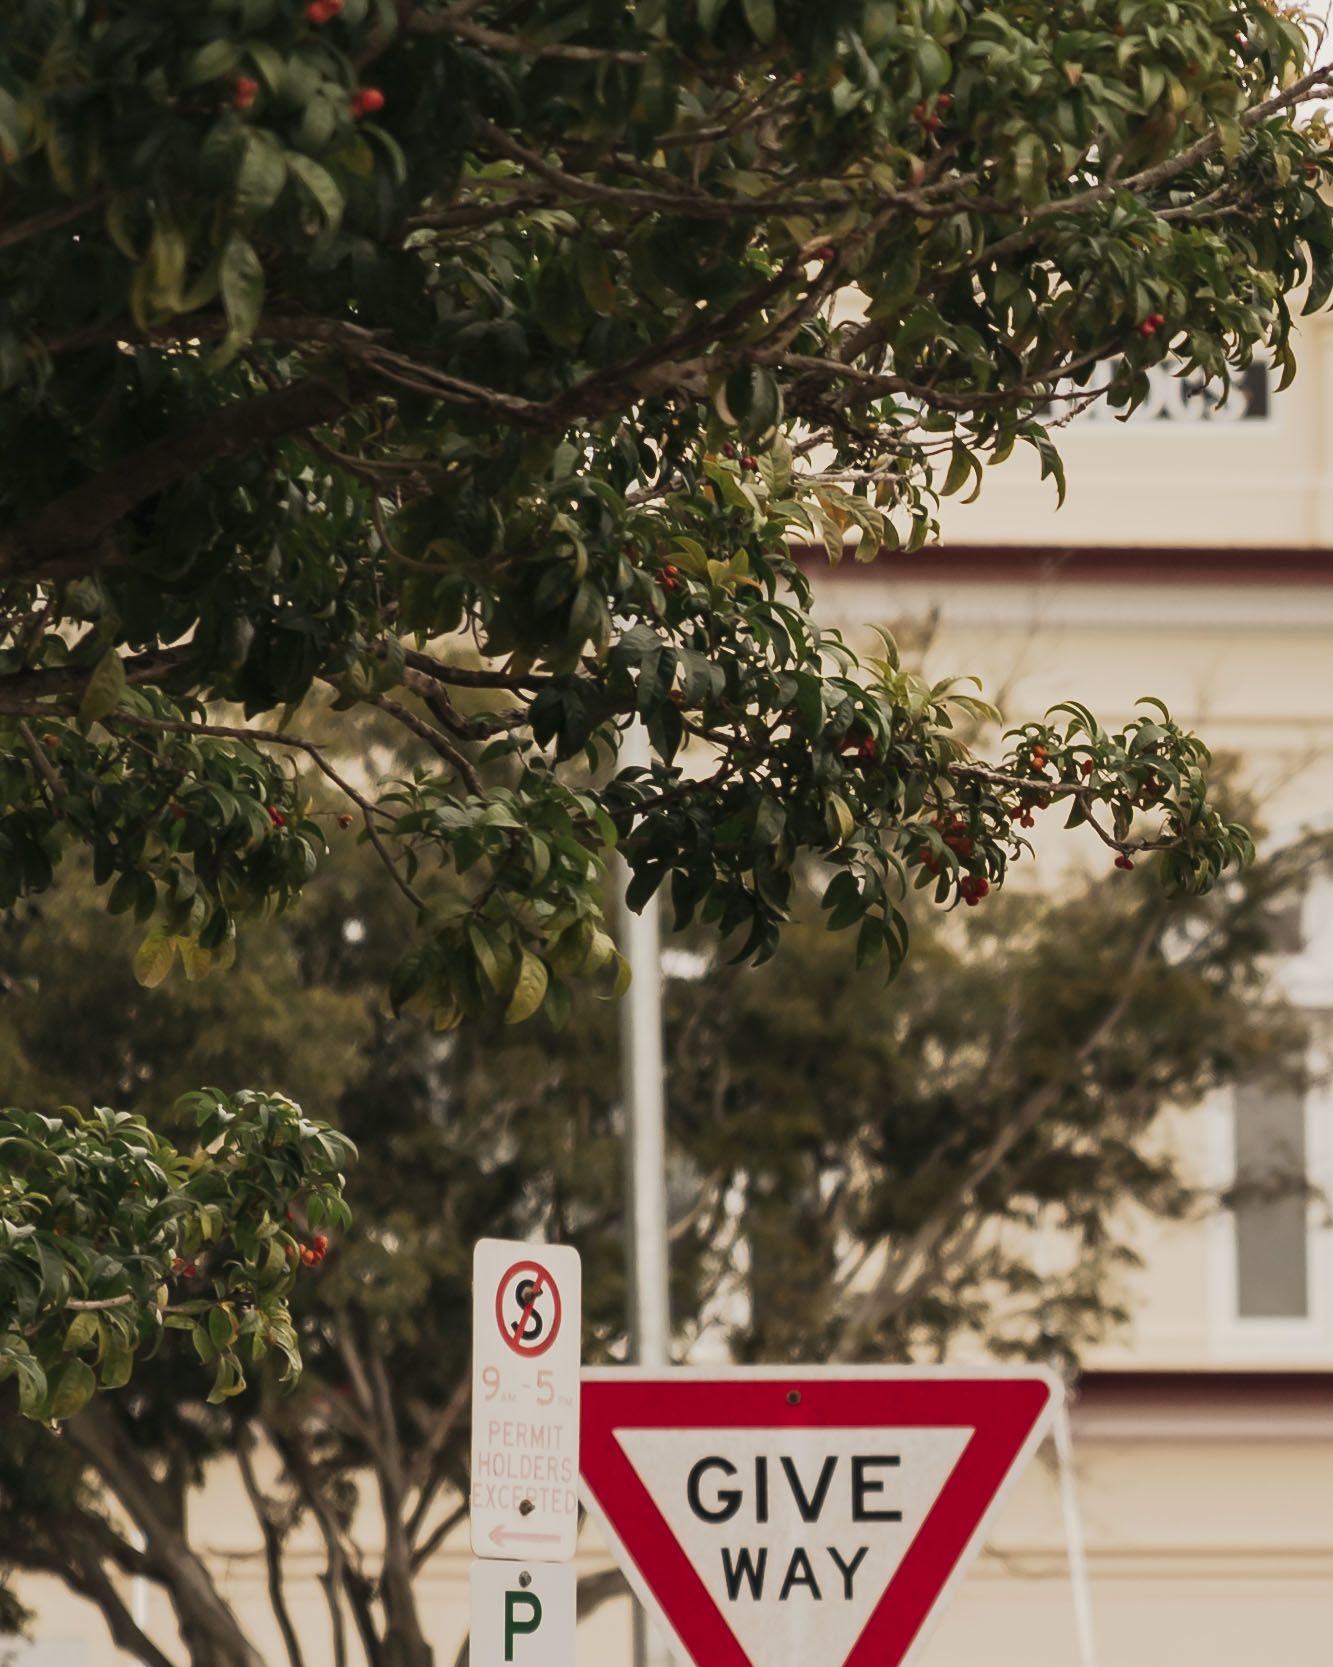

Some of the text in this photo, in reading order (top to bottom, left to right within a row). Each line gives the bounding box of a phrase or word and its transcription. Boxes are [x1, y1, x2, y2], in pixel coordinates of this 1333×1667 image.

[488, 1421, 563, 1449] PERMIT
[478, 1451, 573, 1484] HOLDERS
[687, 1455, 903, 1524] GIVE
[472, 1482, 577, 1514] EXCEPTED
[721, 1546, 869, 1601] WAY
[505, 1590, 542, 1661] P
